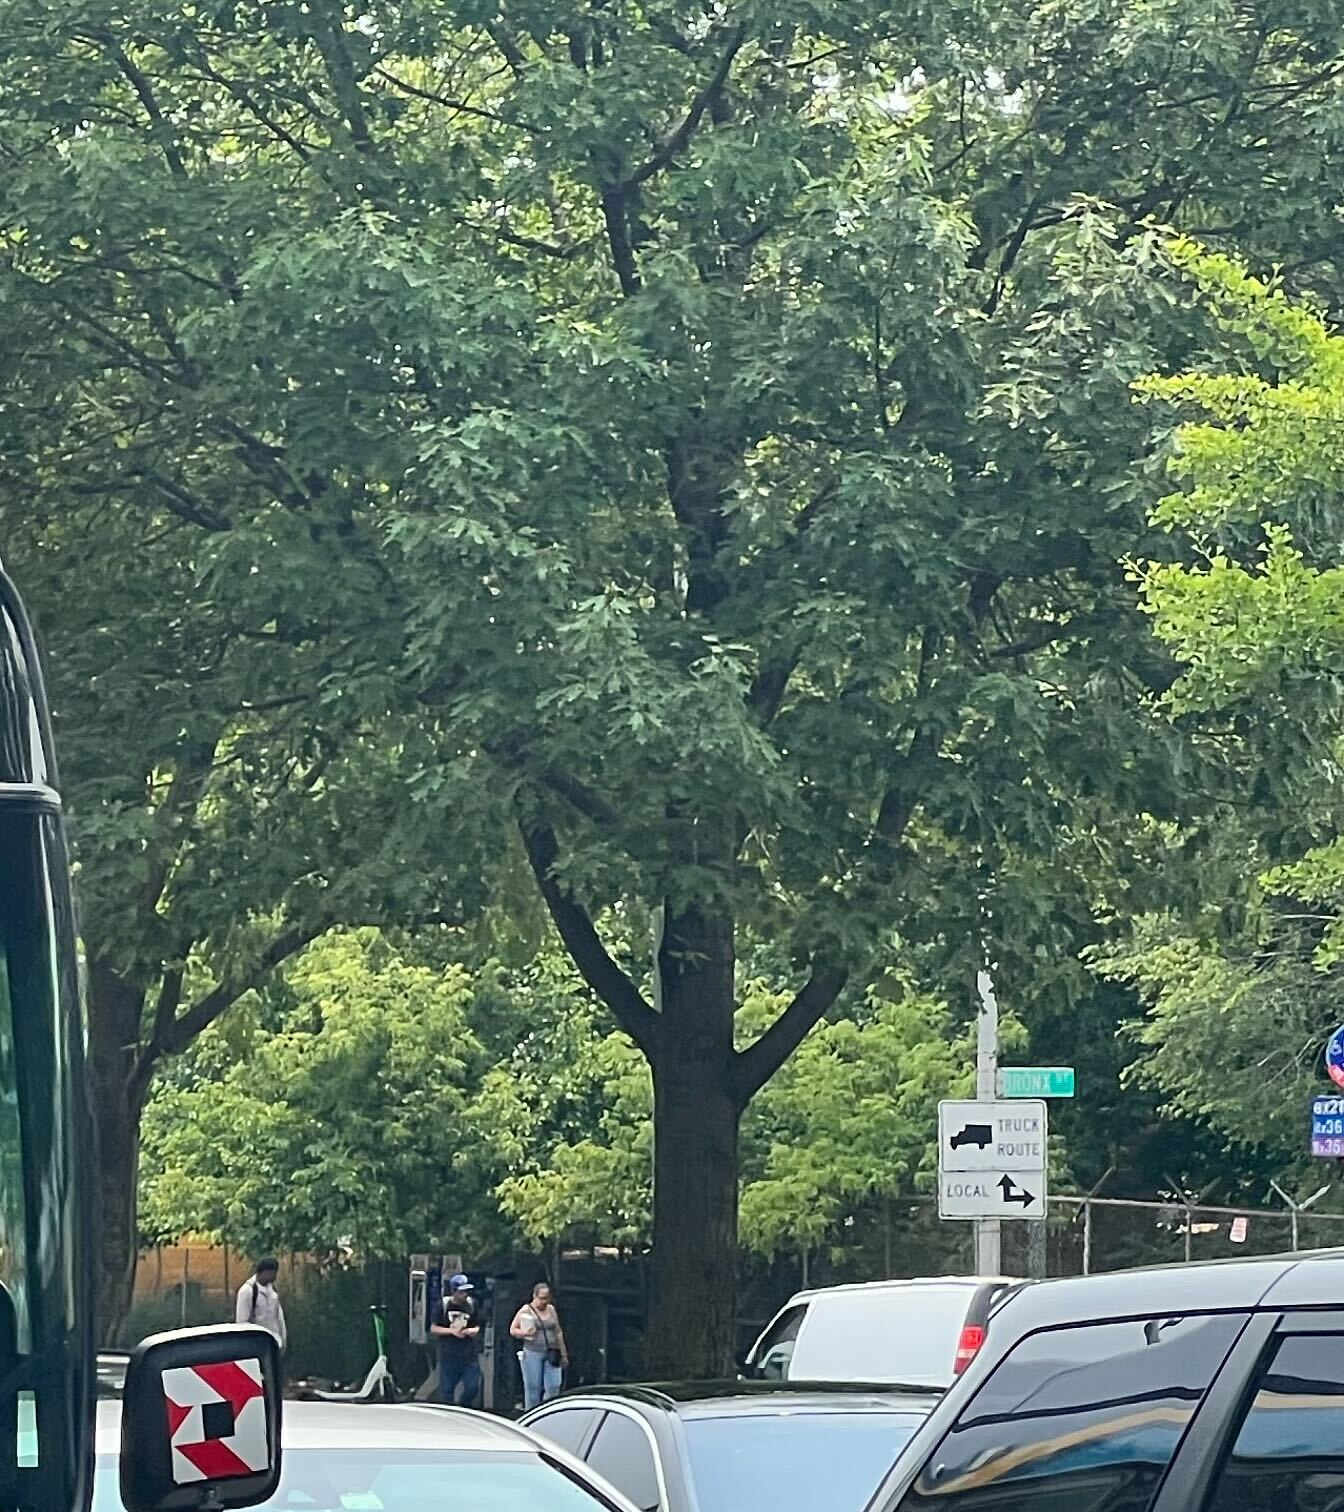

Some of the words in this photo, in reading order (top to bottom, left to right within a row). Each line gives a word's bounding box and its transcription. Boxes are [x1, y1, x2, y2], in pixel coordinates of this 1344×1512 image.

[998, 1118, 1040, 1133] TRUCK
[997, 1143, 1040, 1157] ROUTE
[946, 1183, 990, 1198] LOCAL
